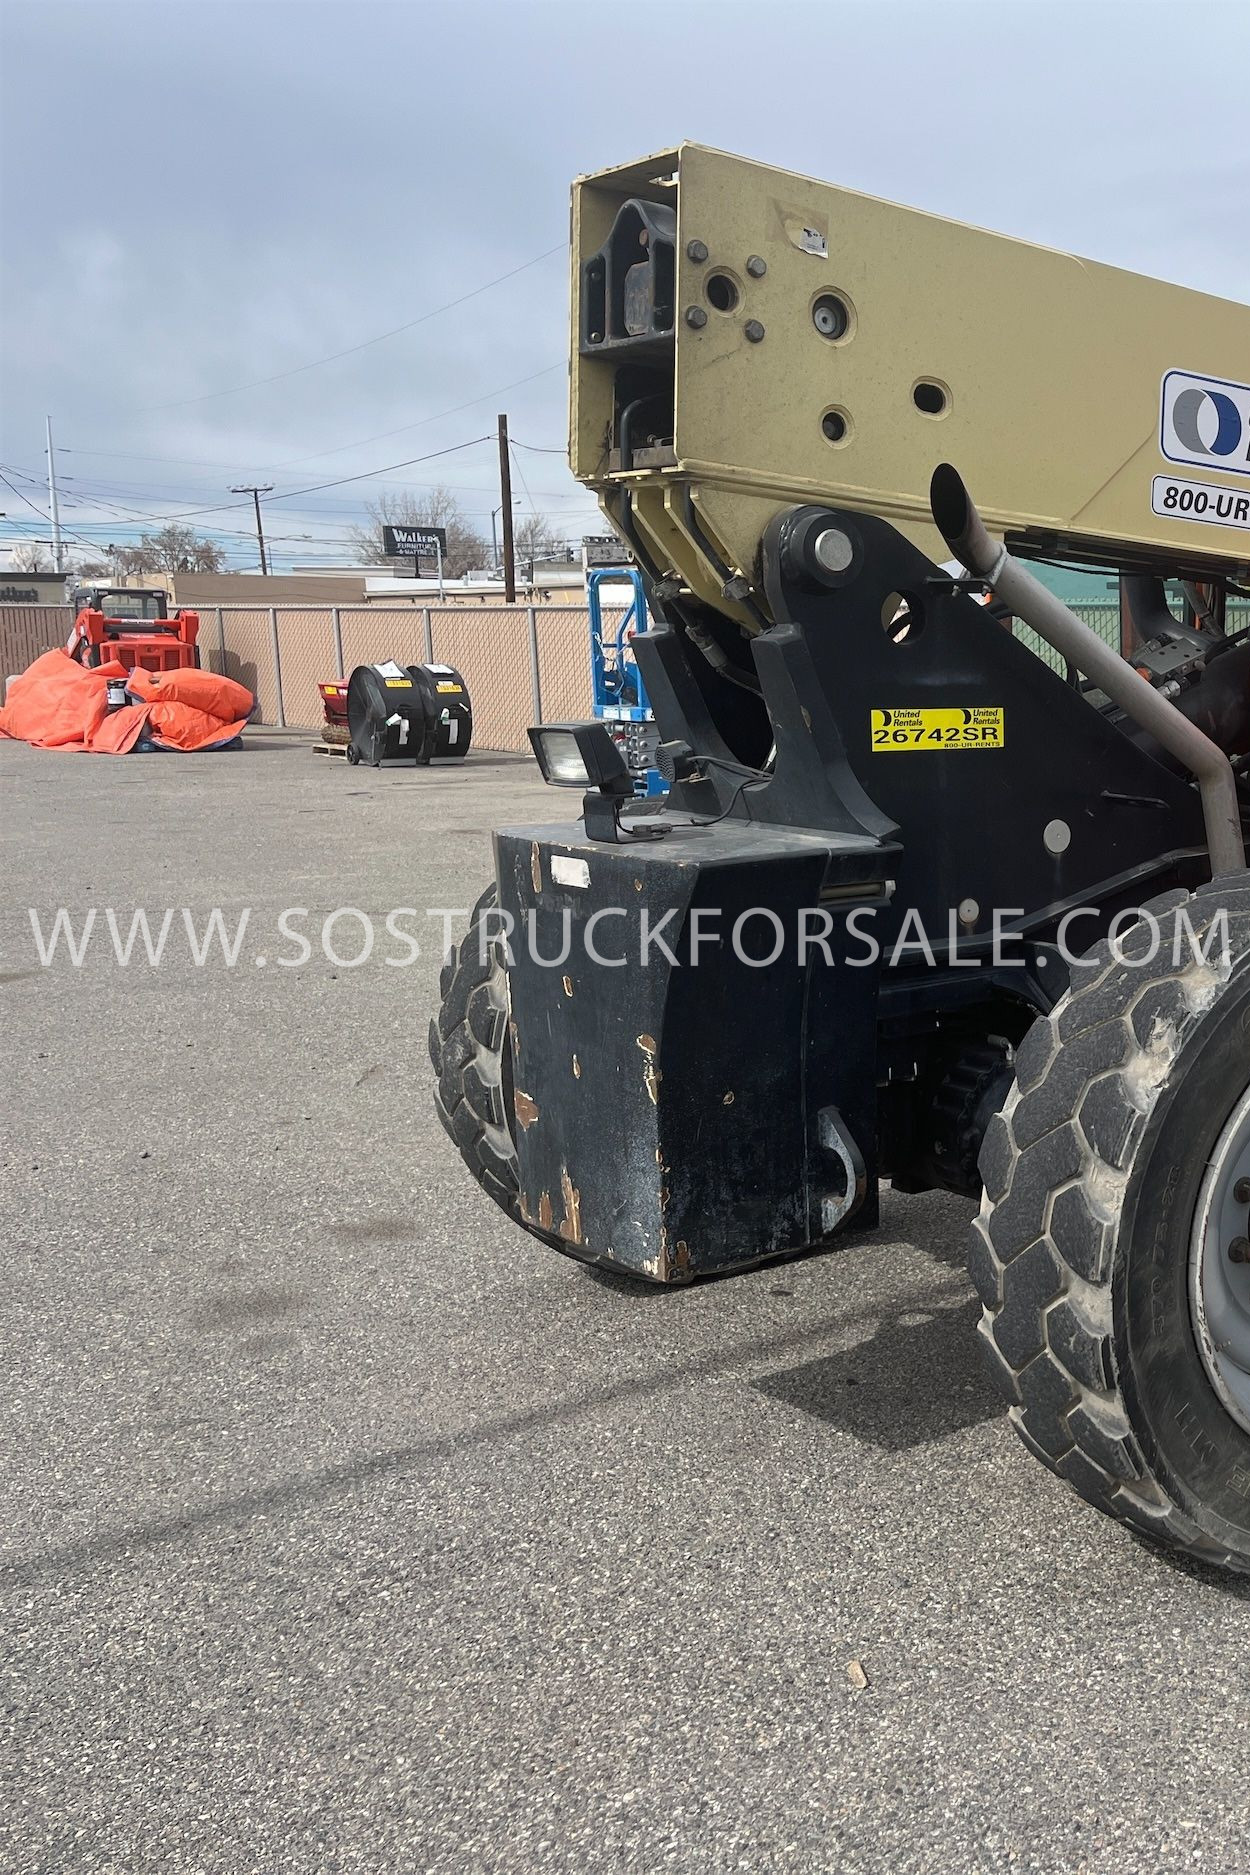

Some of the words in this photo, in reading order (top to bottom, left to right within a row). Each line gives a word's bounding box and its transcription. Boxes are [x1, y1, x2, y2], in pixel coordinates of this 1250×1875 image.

[893, 710, 920, 718] United
[973, 709, 998, 717] United
[893, 718, 923, 727] Rentals
[972, 717, 1000, 725] Rentals
[873, 727, 999, 744] 26742SR
